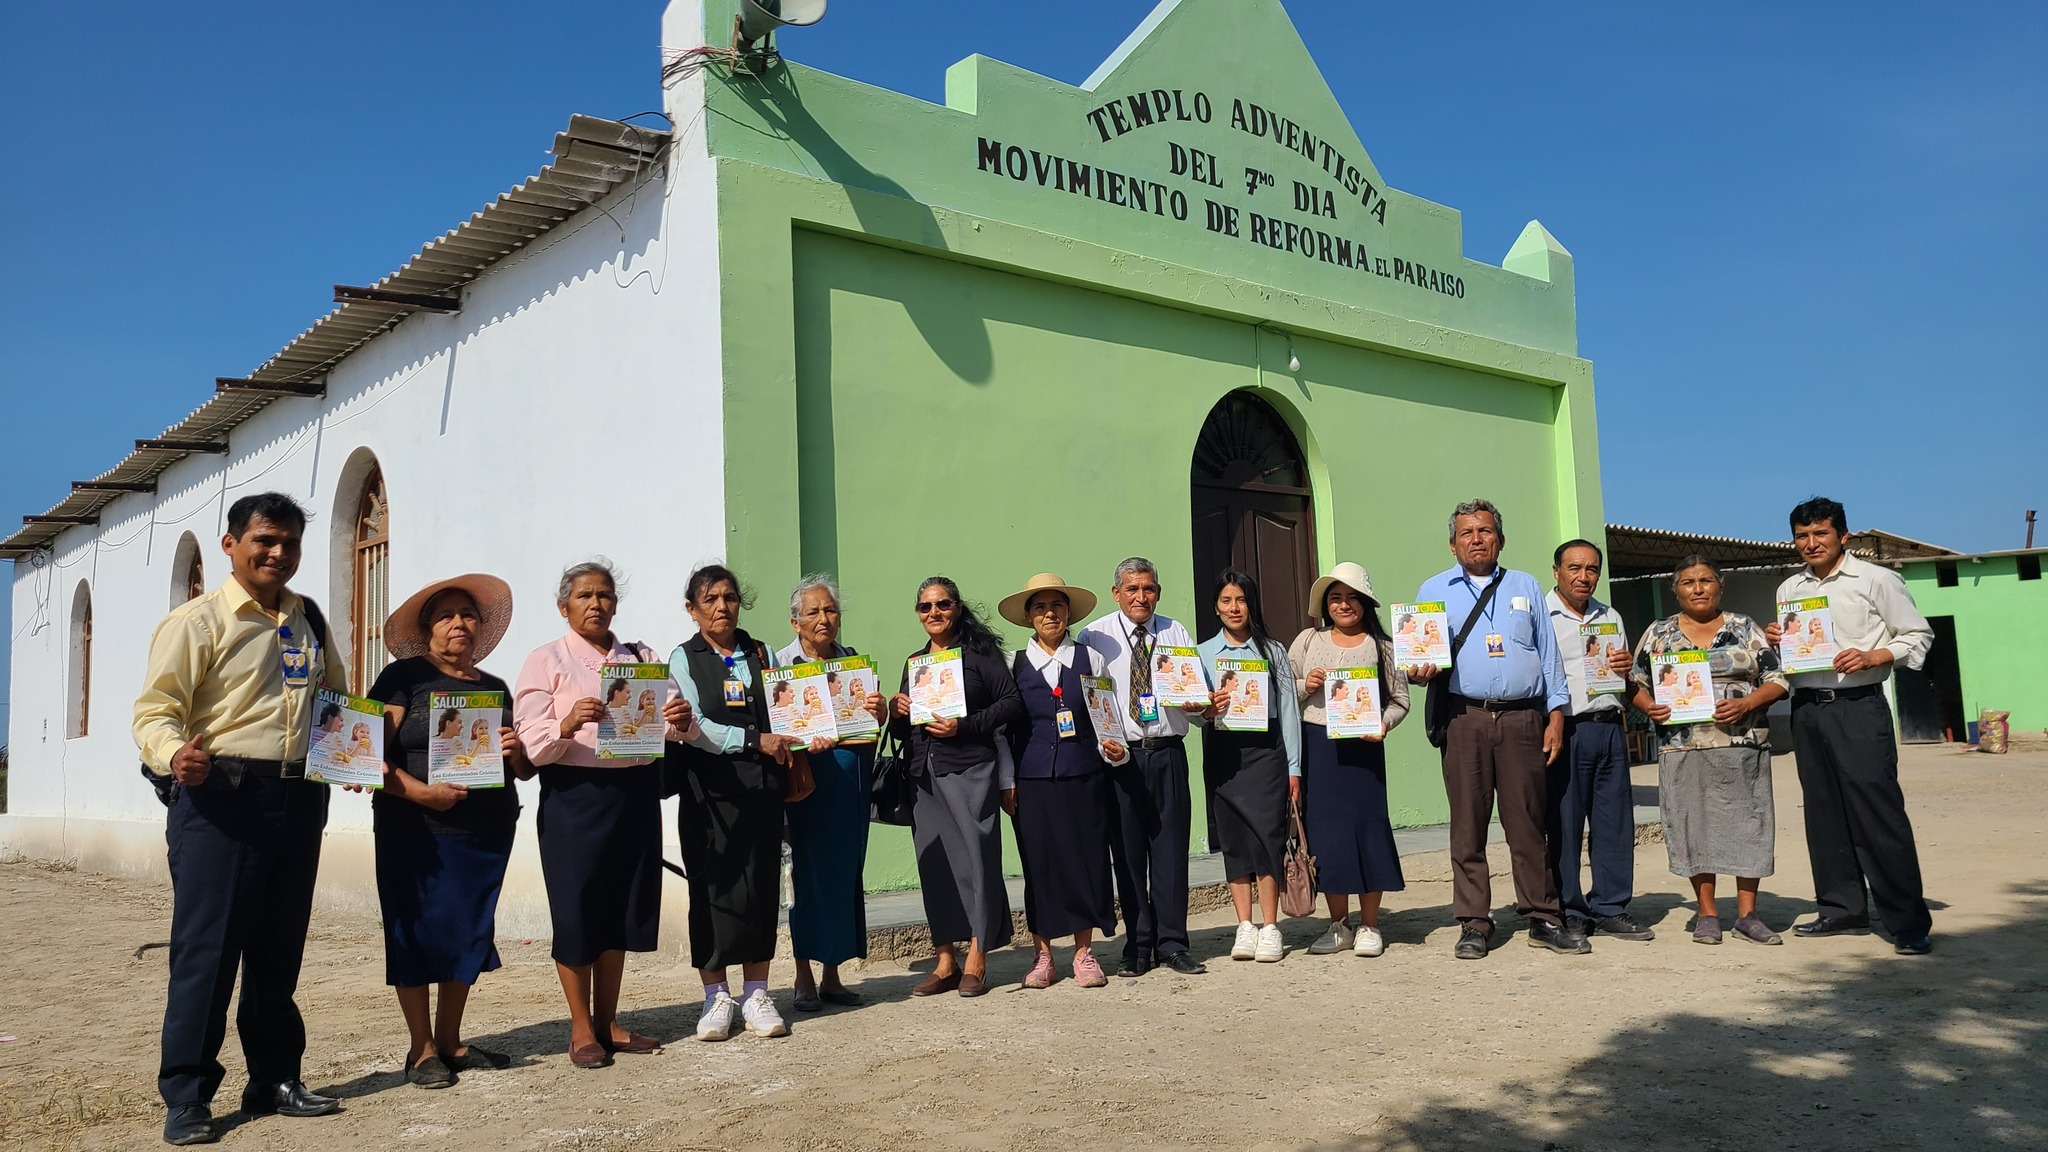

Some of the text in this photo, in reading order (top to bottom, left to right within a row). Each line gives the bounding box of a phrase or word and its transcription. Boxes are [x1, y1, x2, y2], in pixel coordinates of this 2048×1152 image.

[977, 136, 1188, 221] MOVIMIENTO
[1204, 198, 1240, 238] DE
[1393, 257, 1465, 299] PARAISO
[1086, 89, 1387, 226] TEMPLO ADVENTISTA
[1168, 141, 1224, 189] DEL
[1292, 180, 1337, 220] DIA
